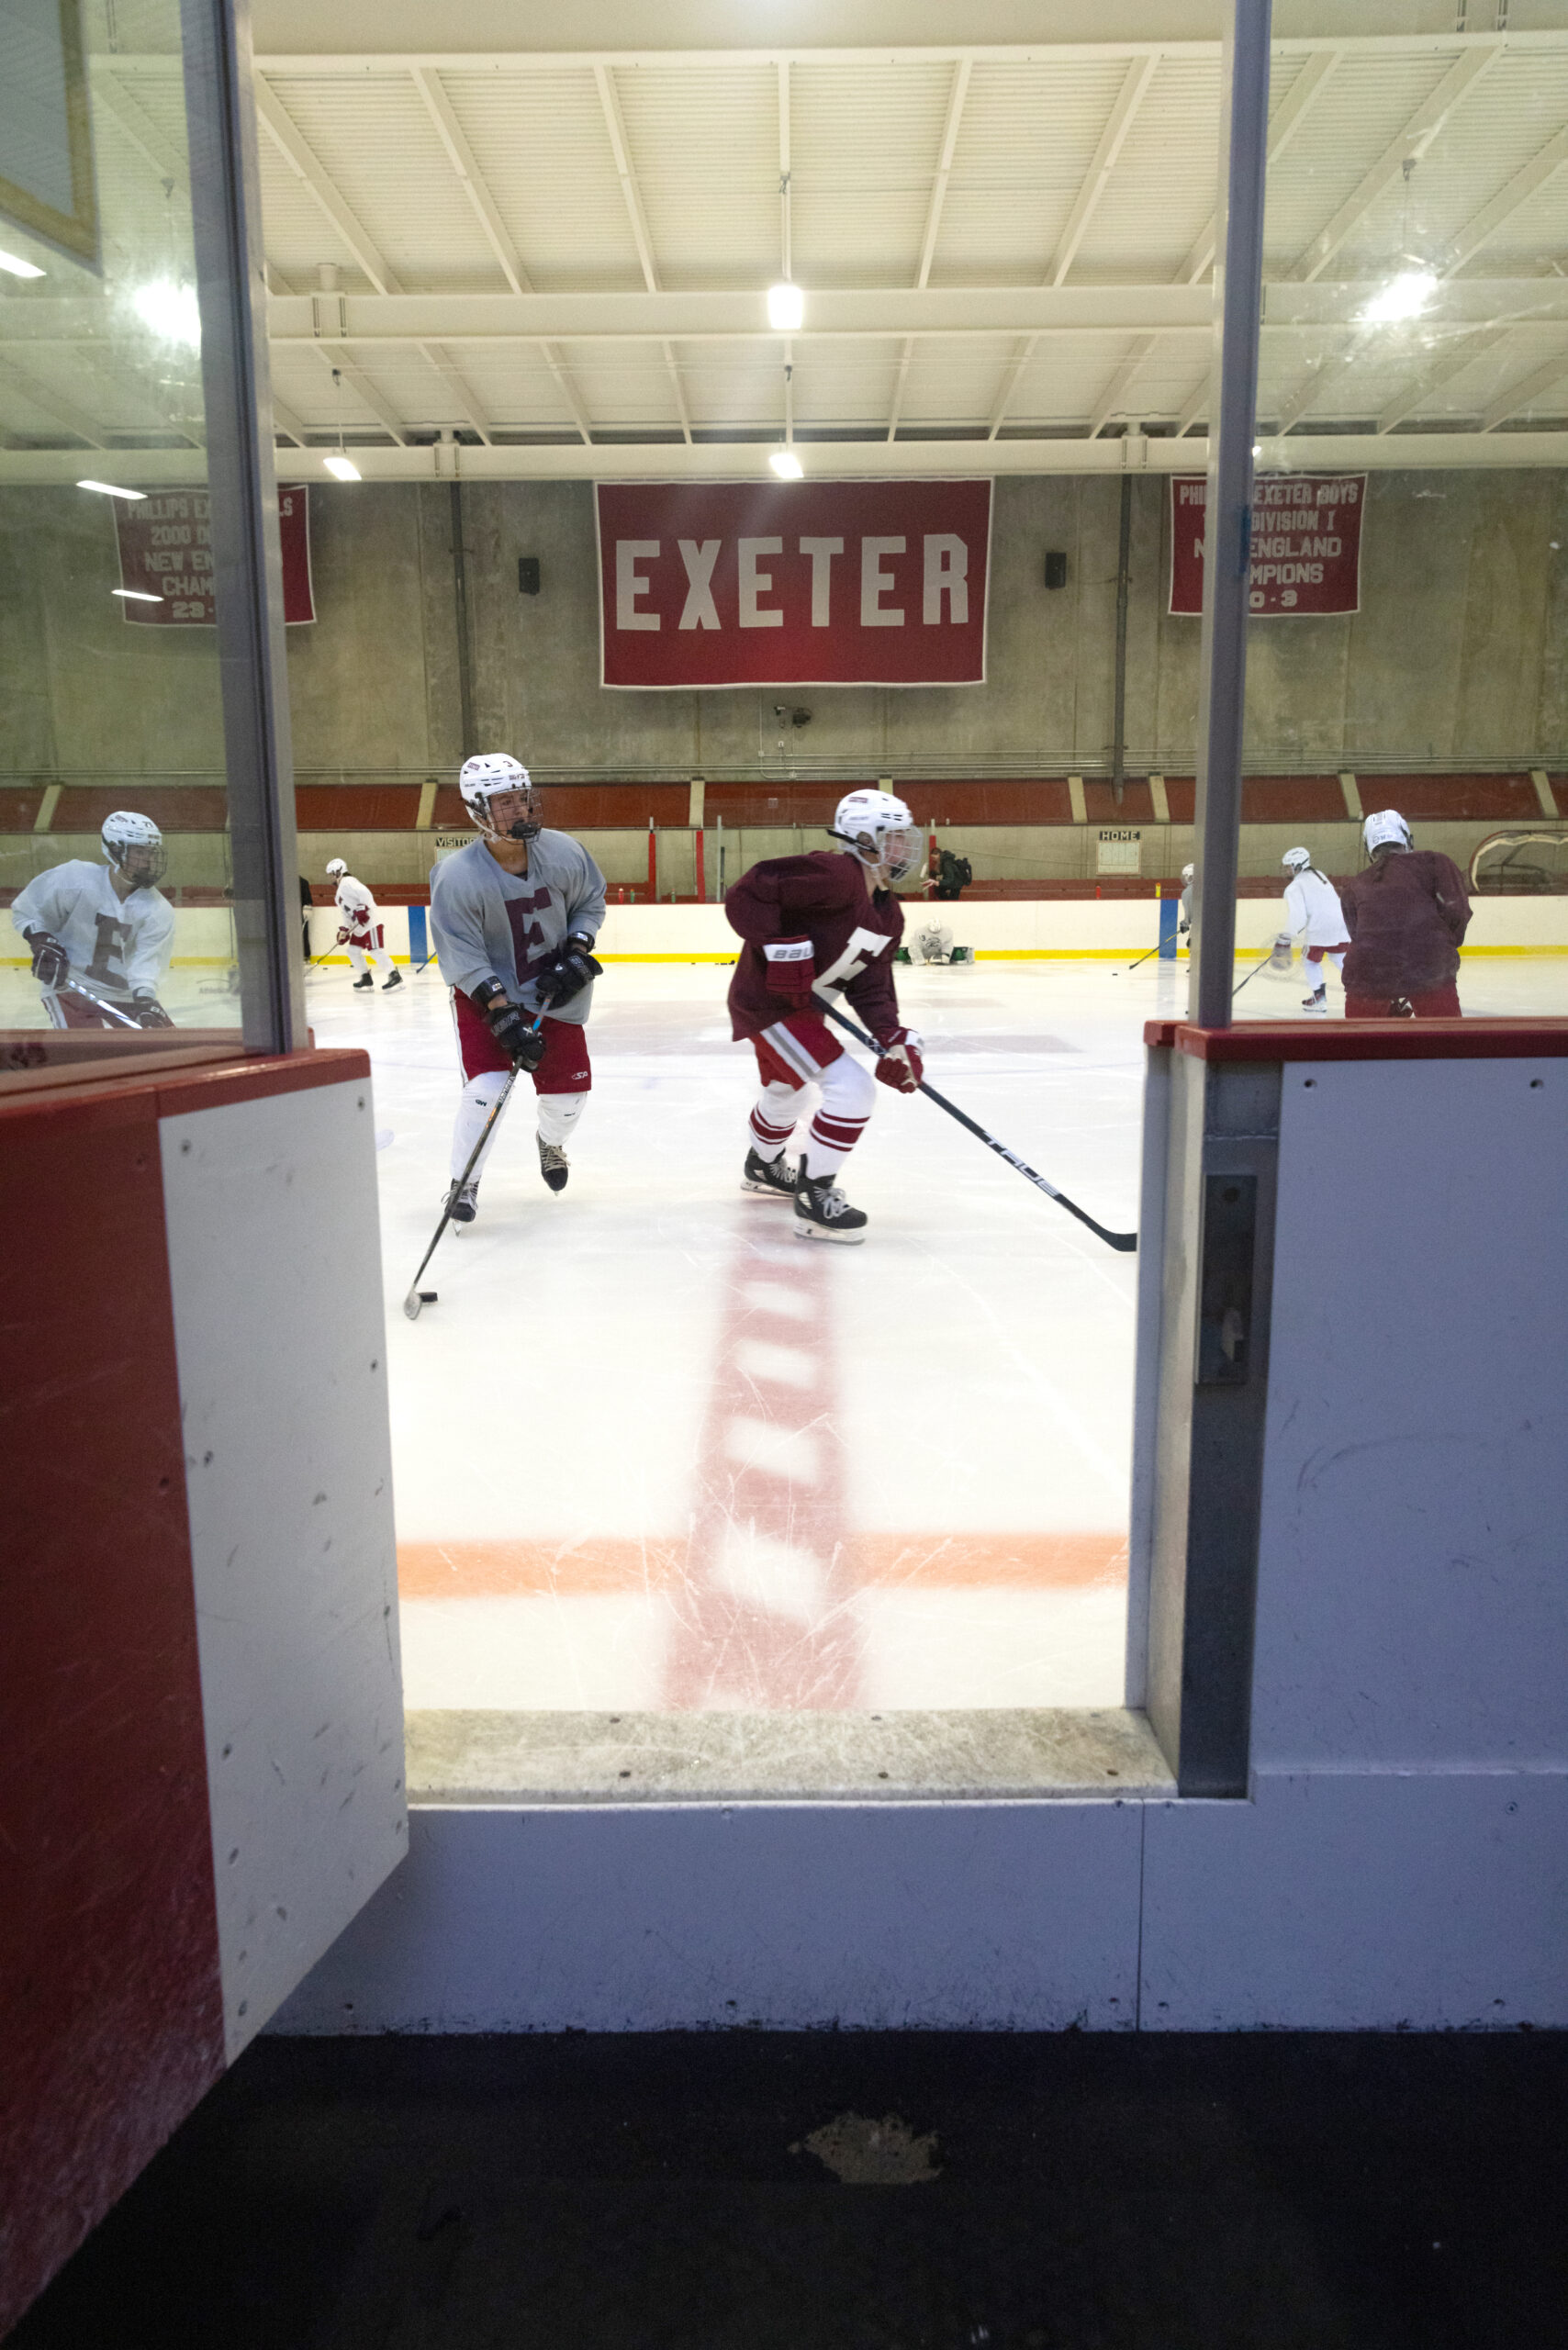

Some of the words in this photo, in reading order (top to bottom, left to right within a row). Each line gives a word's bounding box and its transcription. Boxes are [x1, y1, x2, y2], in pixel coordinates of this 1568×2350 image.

[1253, 485, 1312, 504] EXETER
[1320, 484, 1359, 504] BOYS
[1251, 511, 1319, 532] DIVISION
[151, 525, 192, 545] 2000
[144, 551, 184, 572] NEW
[616, 533, 969, 631] EXETER
[1249, 563, 1325, 585] MPIONS
[1102, 831, 1138, 841] HOME
[982, 1130, 1061, 1198] TRUE
